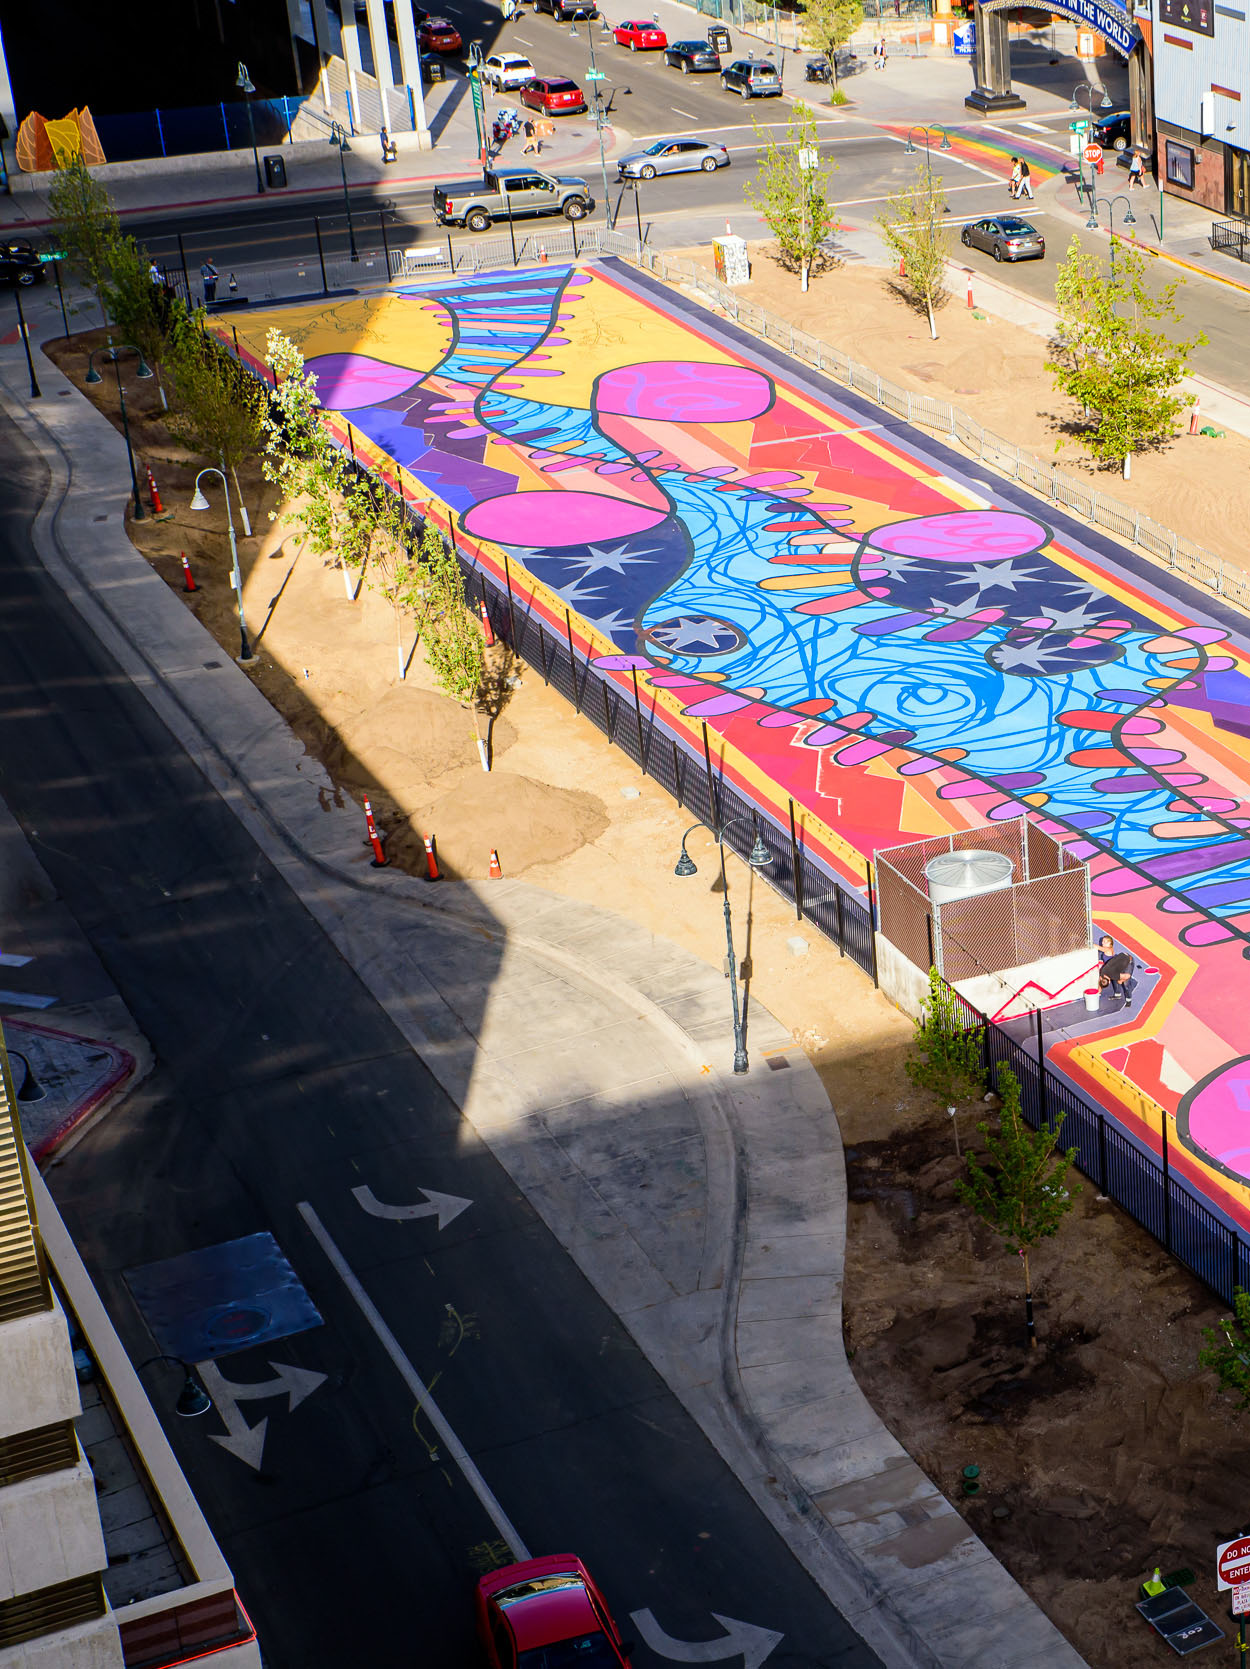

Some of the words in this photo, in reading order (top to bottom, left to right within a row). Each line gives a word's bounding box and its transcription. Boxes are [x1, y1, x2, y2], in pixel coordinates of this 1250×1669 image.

[1079, 1, 1095, 20] THE
[1096, 8, 1130, 48] WORLD
[1085, 149, 1101, 158] STOP
[1227, 1549, 1238, 1559] DO
